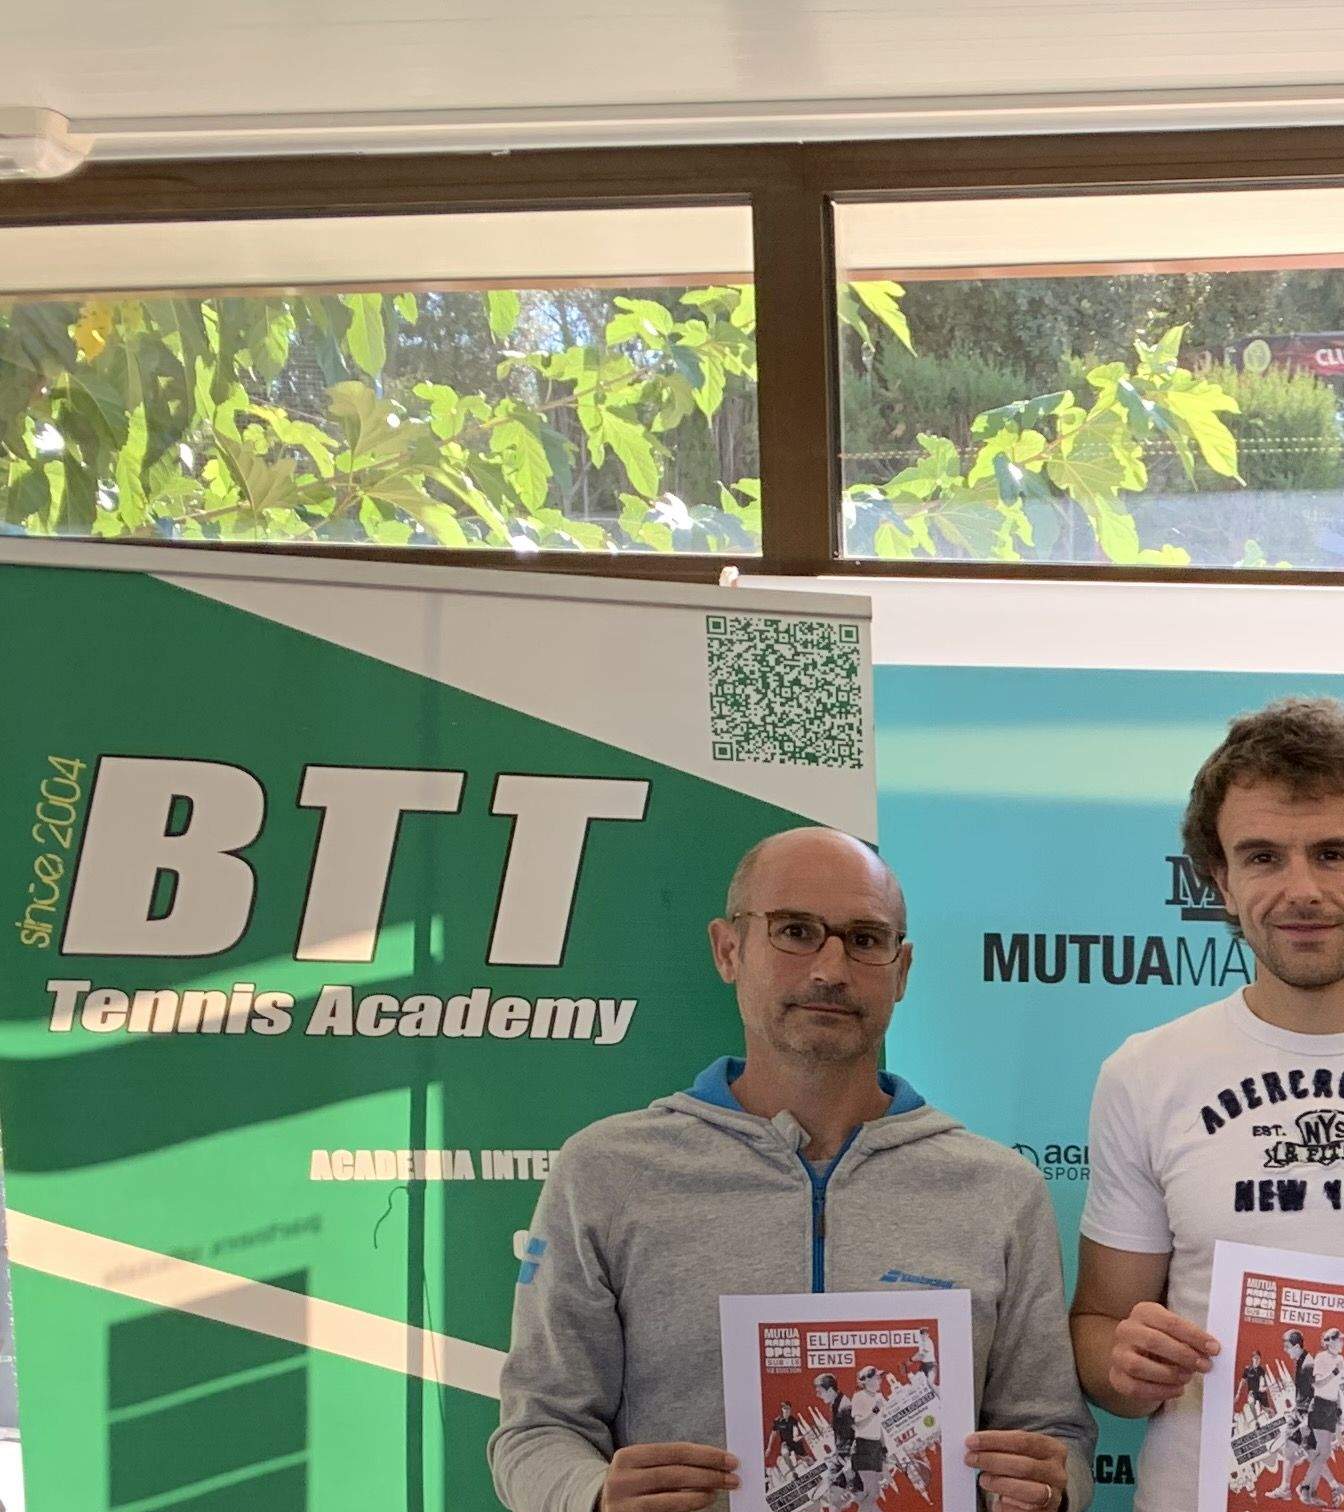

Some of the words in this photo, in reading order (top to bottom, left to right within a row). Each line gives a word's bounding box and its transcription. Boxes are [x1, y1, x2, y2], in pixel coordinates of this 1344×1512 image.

[35, 754, 88, 846] 2004
[60, 754, 653, 968] BTT
[46, 979, 294, 1037] Tennis
[304, 985, 638, 1046] Academy
[1252, 1124, 1287, 1138] EST.
[310, 1149, 476, 1181] ACADEMIA
[1234, 1179, 1307, 1213] NEW
[1284, 1290, 1298, 1304] EL
[1282, 1310, 1321, 1325] TENIS
[808, 1335, 827, 1347] EL
[831, 1334, 889, 1347] FUTURO
[893, 1332, 919, 1345] DEL
[809, 1353, 854, 1367] TENIS
